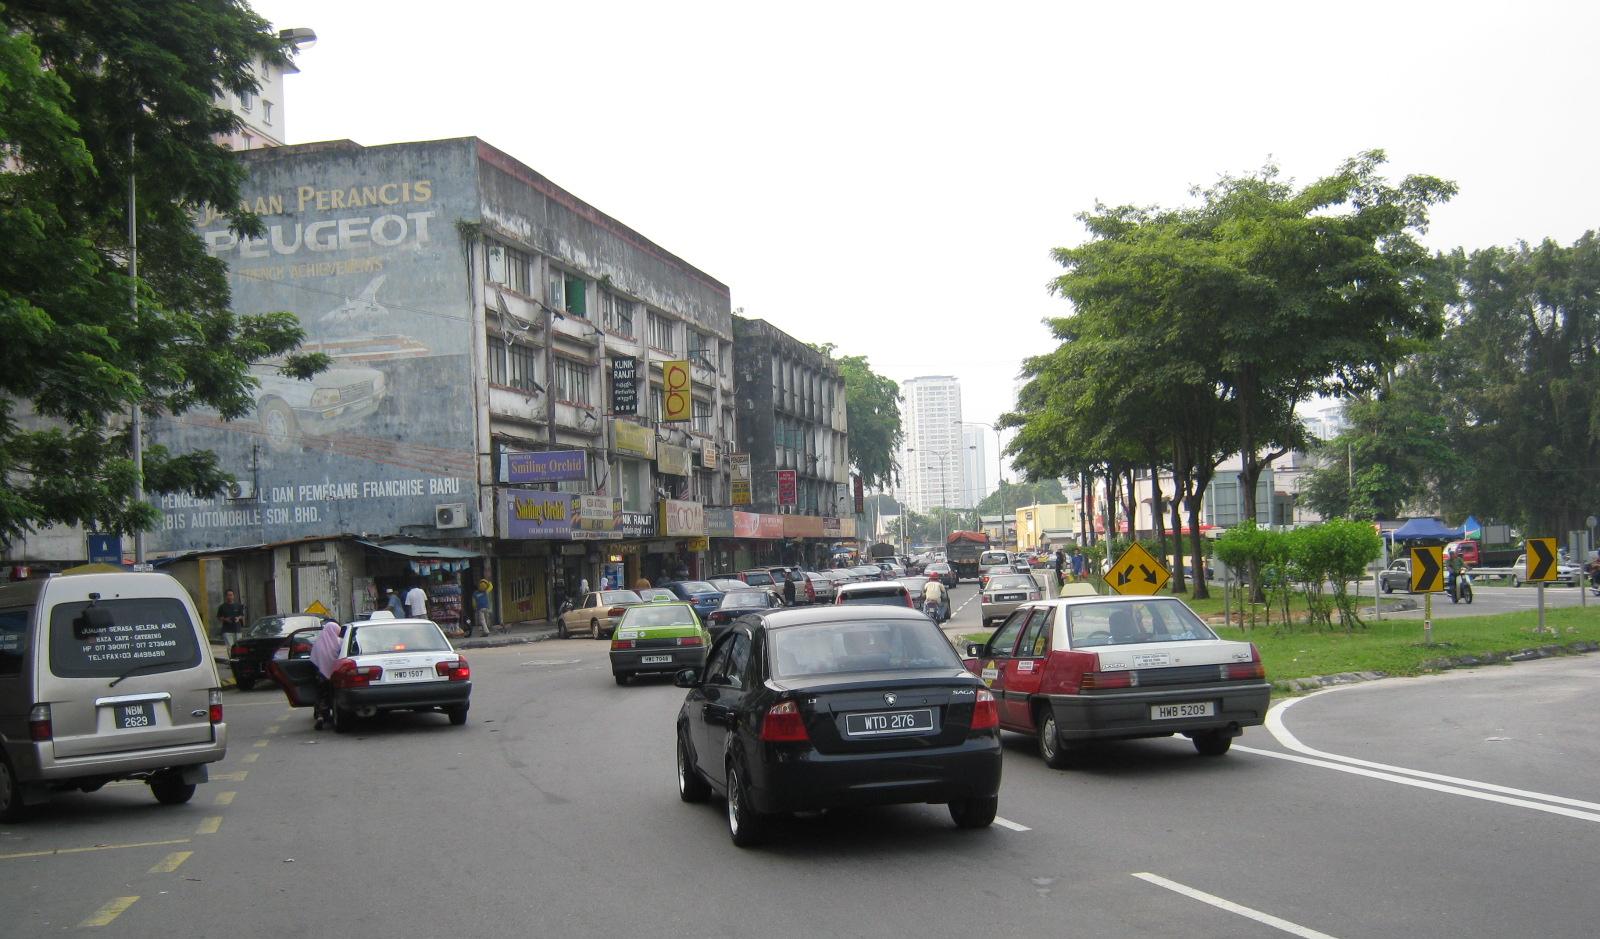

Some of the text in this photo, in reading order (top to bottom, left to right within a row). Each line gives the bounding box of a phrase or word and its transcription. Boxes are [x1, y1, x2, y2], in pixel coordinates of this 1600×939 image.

[298, 180, 432, 212] PERANCIS
[205, 211, 436, 259] PEUGEOT
[614, 360, 634, 369] KLINIK
[613, 370, 635, 379] RANJIT
[511, 458, 582, 475] Smiling Orchid
[272, 486, 294, 502] DAN
[363, 479, 424, 498] FRANCHISE
[429, 477, 460, 495] BARU
[191, 509, 262, 529] AUTOMOBILE
[266, 507, 293, 525] SDN.
[295, 506, 322, 524] BHD.
[514, 496, 544, 524] Smiling
[633, 515, 652, 525] RANJIT
[408, 670, 424, 678] 1507
[125, 705, 144, 716] NBM
[1159, 704, 1206, 718] HWB 5209
[124, 716, 149, 728] 2629
[864, 714, 915, 730] WTD 2176
